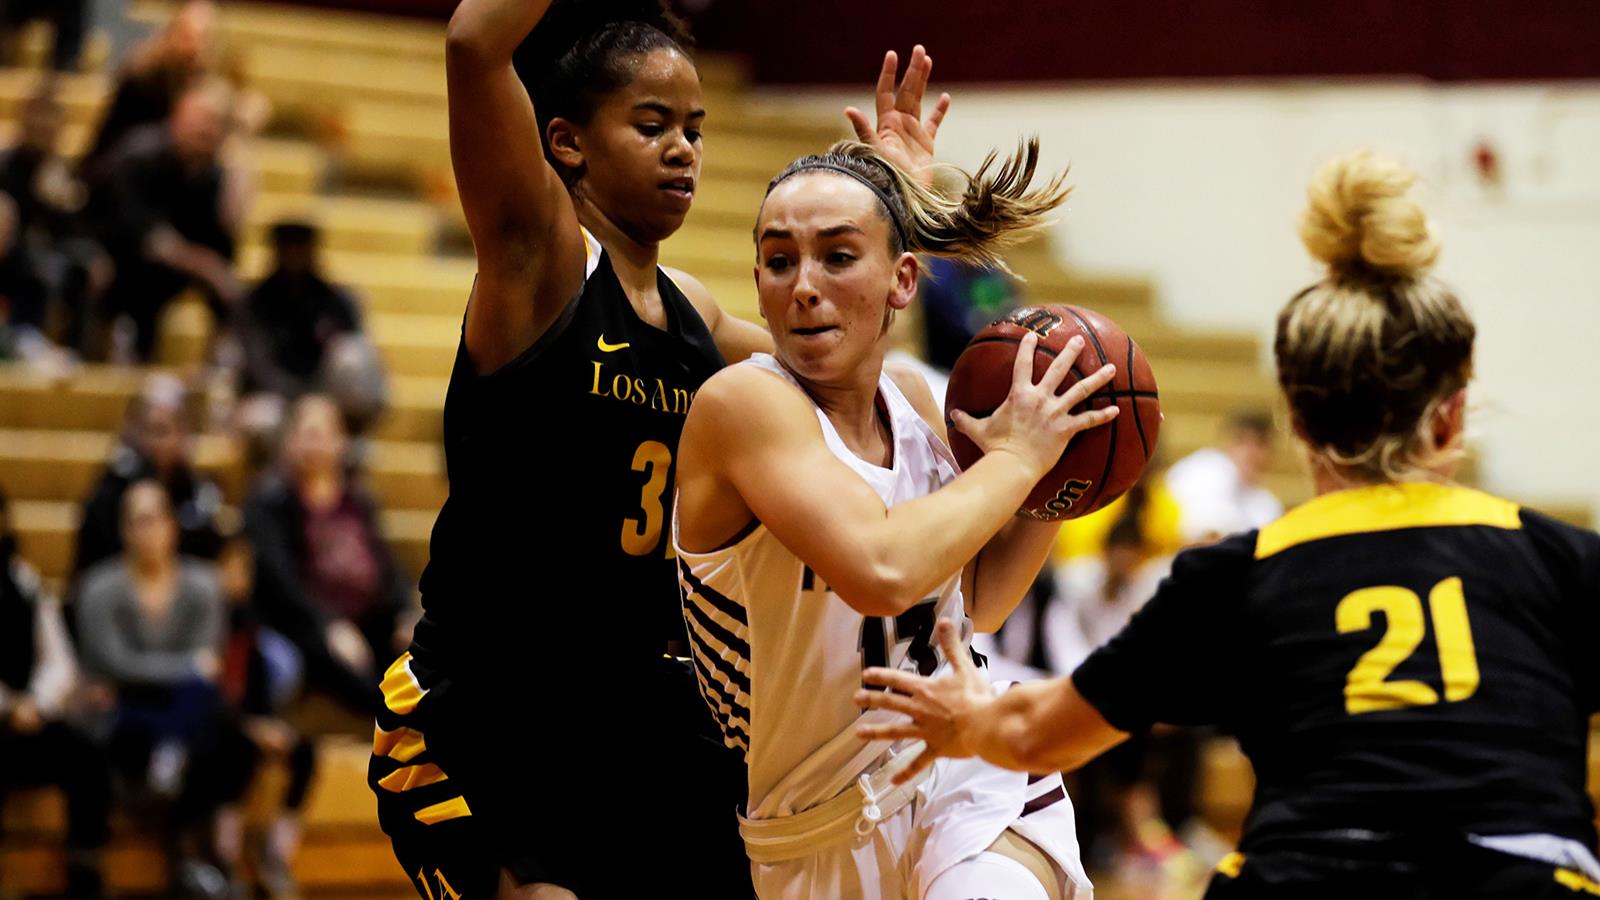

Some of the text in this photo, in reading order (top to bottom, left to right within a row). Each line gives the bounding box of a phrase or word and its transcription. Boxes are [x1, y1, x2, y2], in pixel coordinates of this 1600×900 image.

[588, 360, 647, 405] Los
[621, 440, 678, 560] 3
[1335, 576, 1480, 715] 21
